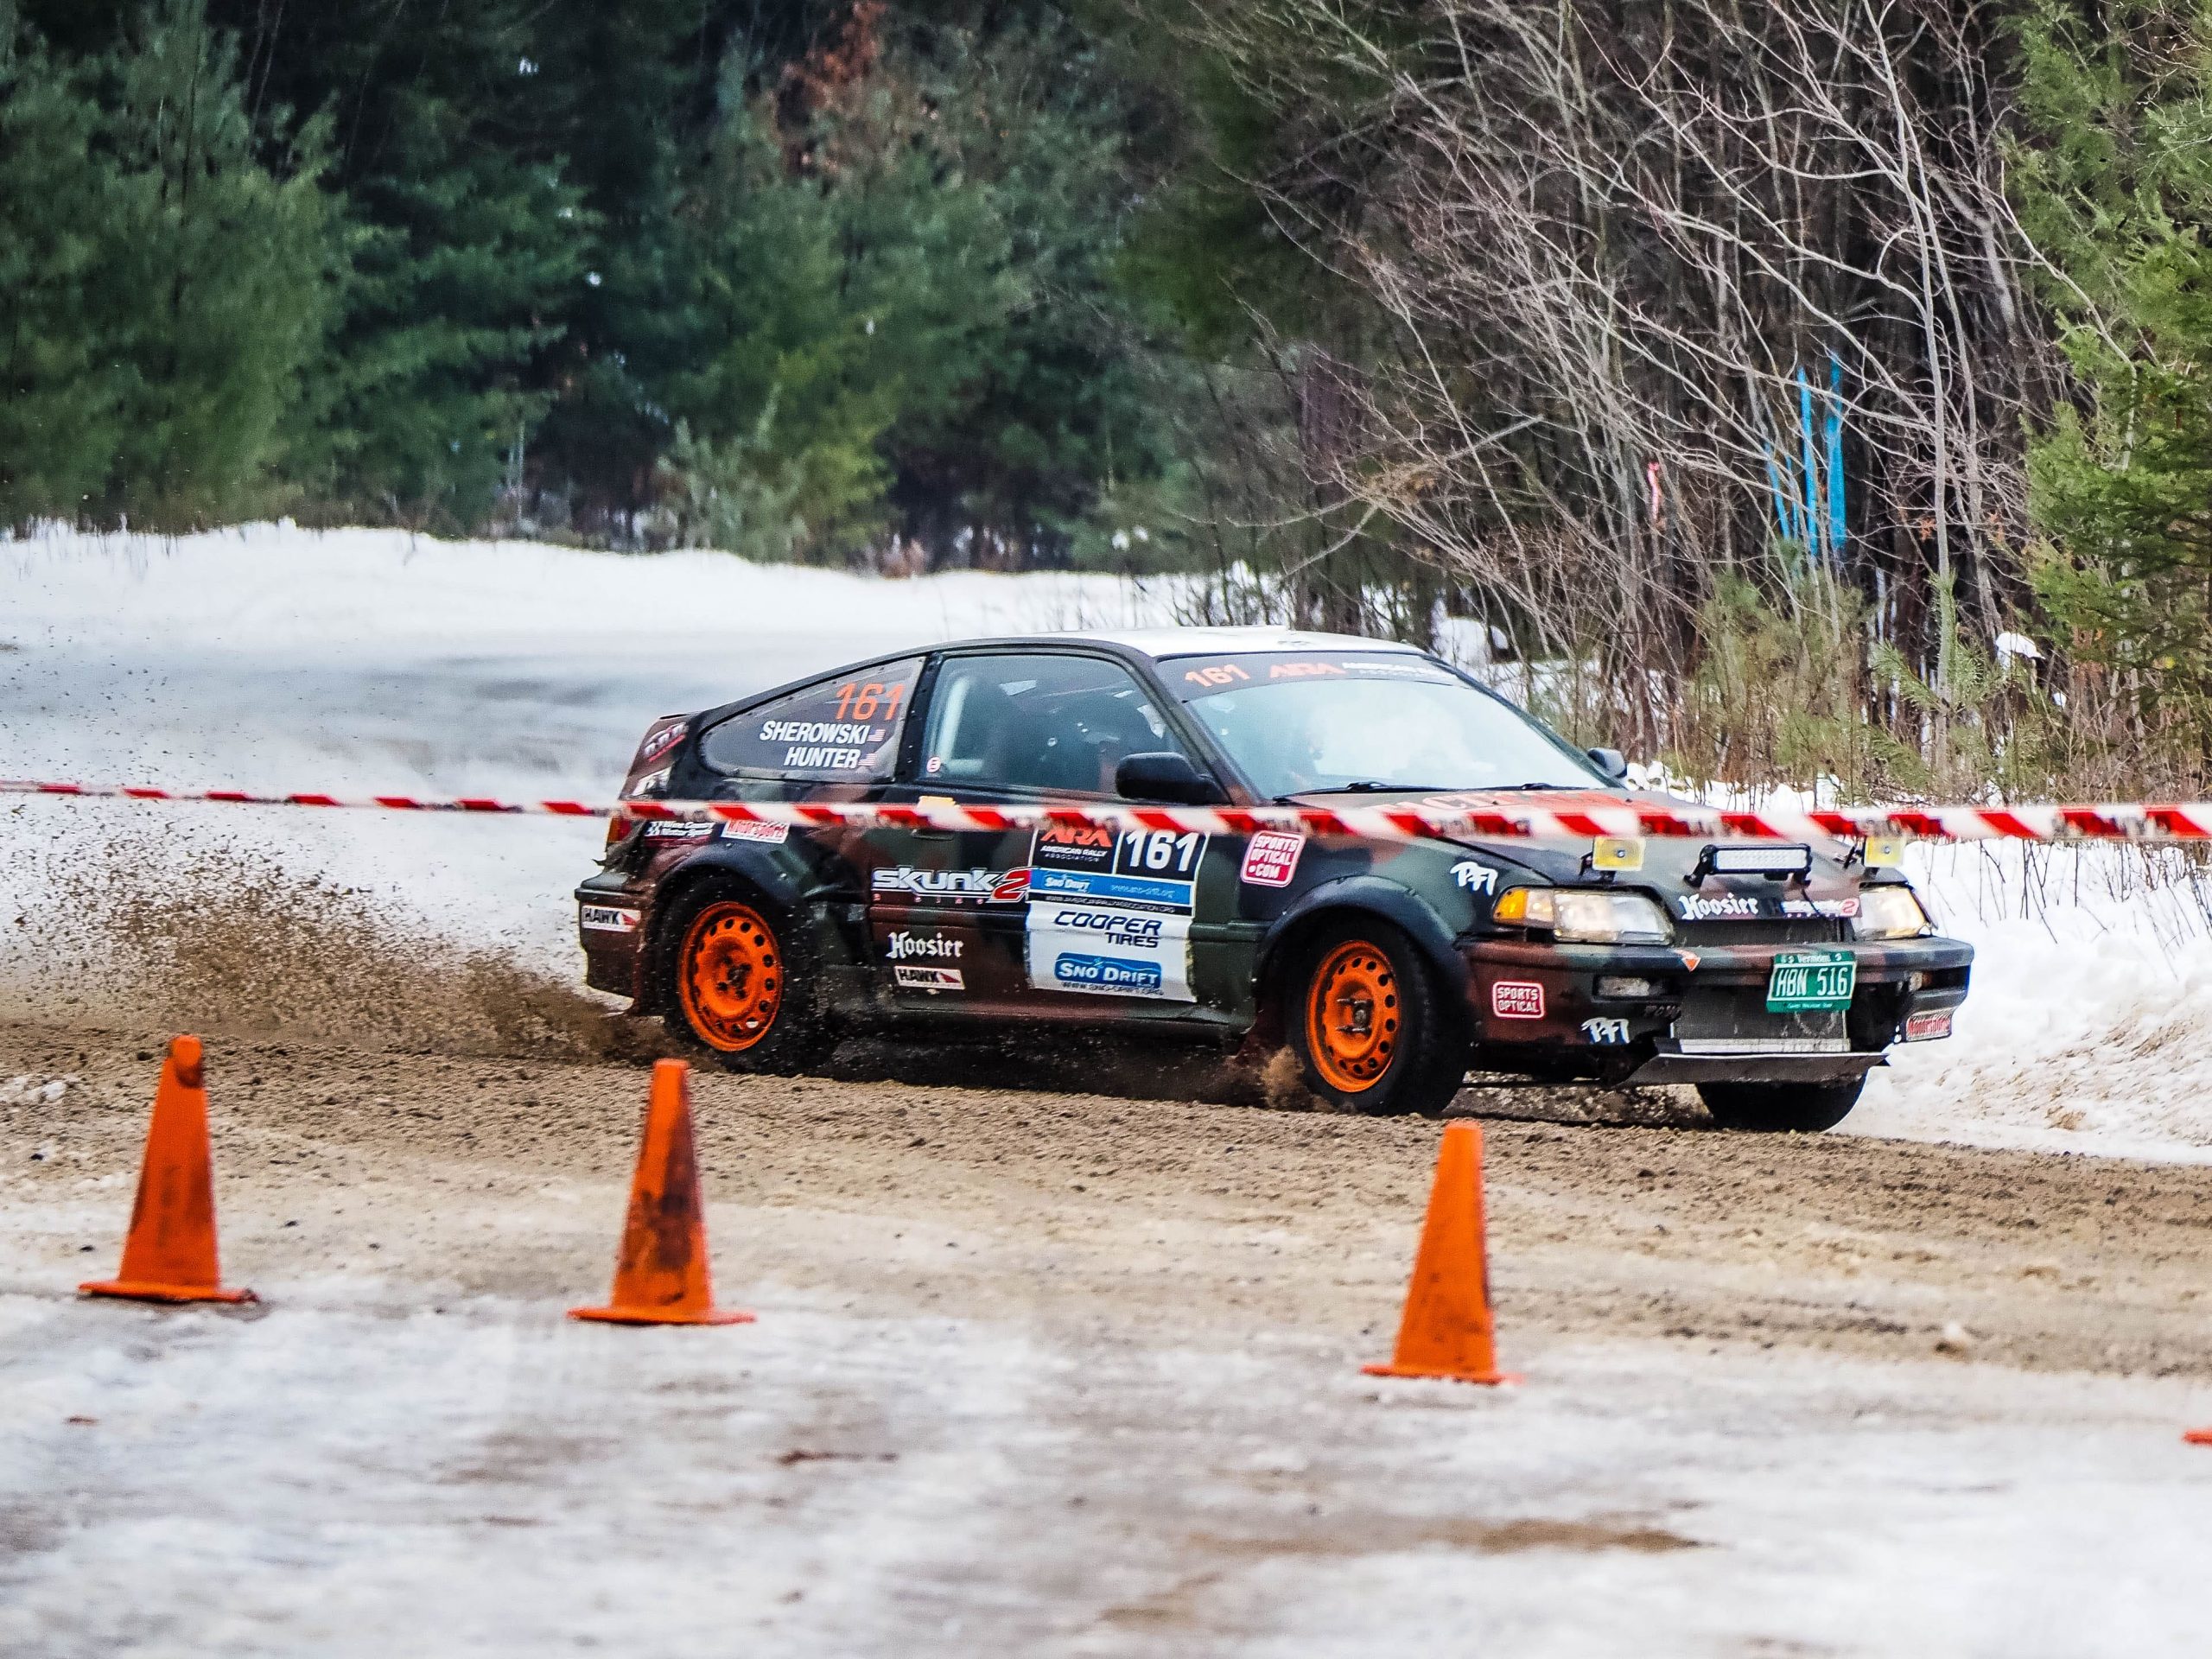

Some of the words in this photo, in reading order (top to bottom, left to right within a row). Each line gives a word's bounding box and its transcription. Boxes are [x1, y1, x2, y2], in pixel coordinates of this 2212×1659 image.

[1185, 664, 1250, 688] 161
[836, 683, 906, 721] 161
[760, 720, 871, 745] SHEROWSKI
[783, 747, 861, 768] HUNTER
[1126, 830, 1199, 872] 161
[1255, 836, 1300, 852] SPORTS
[1250, 849, 1294, 866] OPTICAL
[1679, 892, 1759, 920] Hoosier
[1054, 911, 1163, 936] COOPER
[886, 931, 964, 959] Hoosier
[1104, 931, 1160, 949] TIRES
[1058, 961, 1100, 979] SNO
[1103, 965, 1159, 984] DRIFT
[1776, 968, 1809, 997] HBN
[1816, 967, 1848, 996] 516
[1497, 987, 1539, 1001] SPORTS
[1498, 999, 1540, 1013] OPTICAL
